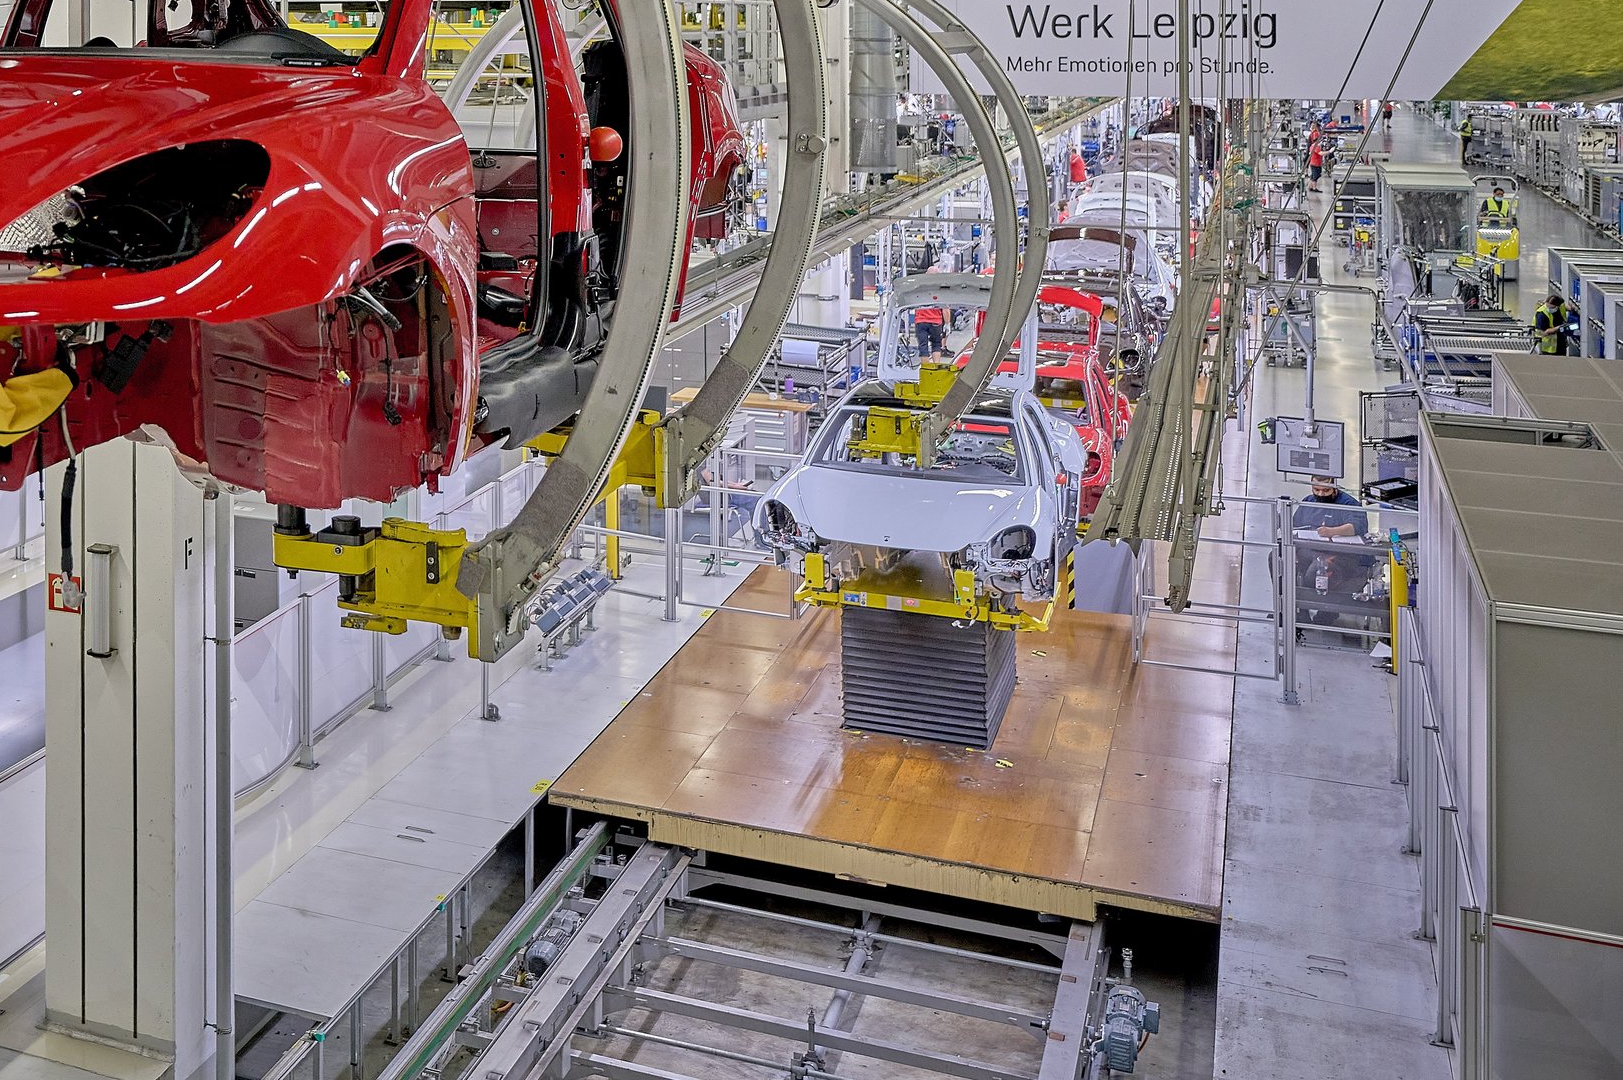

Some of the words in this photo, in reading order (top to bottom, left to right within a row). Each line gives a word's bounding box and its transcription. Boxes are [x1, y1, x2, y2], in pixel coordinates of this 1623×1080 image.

[1006, 4, 1114, 38] Werk
[1131, 3, 1277, 49] Lepzig
[1006, 56, 1052, 72] Mehr
[1058, 56, 1157, 73] Emotionen
[1201, 57, 1274, 74] Stunde.
